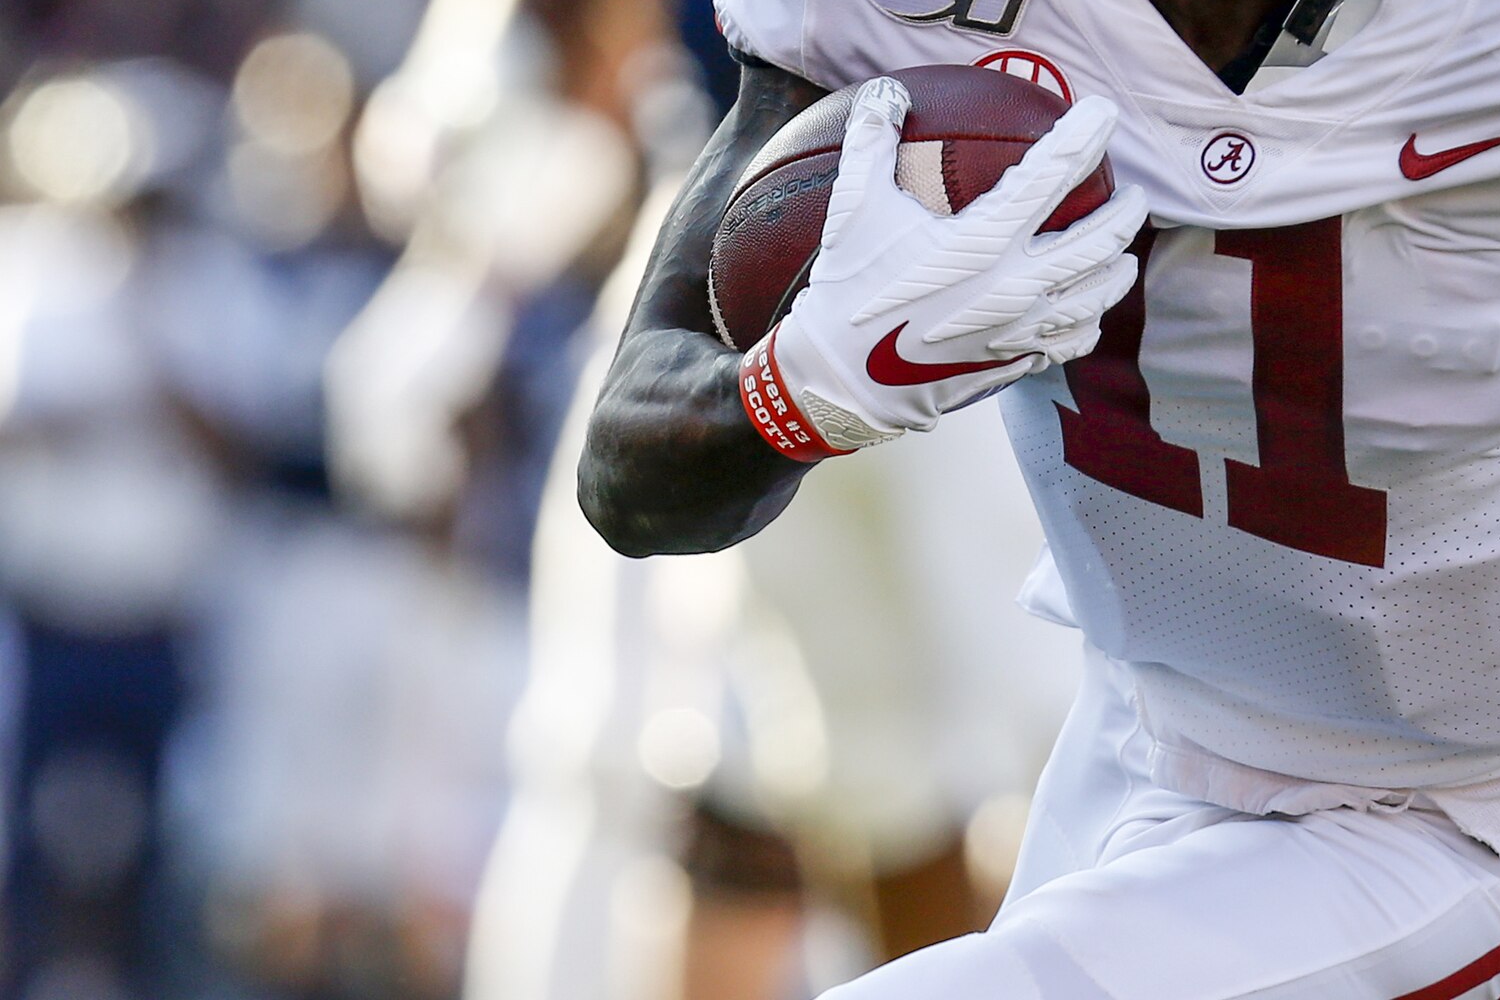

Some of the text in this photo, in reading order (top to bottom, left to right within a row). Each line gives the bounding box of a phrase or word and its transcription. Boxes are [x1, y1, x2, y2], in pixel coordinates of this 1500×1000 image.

[744, 375, 796, 449] SCOTT
[1053, 215, 1389, 569] 11
[785, 420, 811, 444] #3
